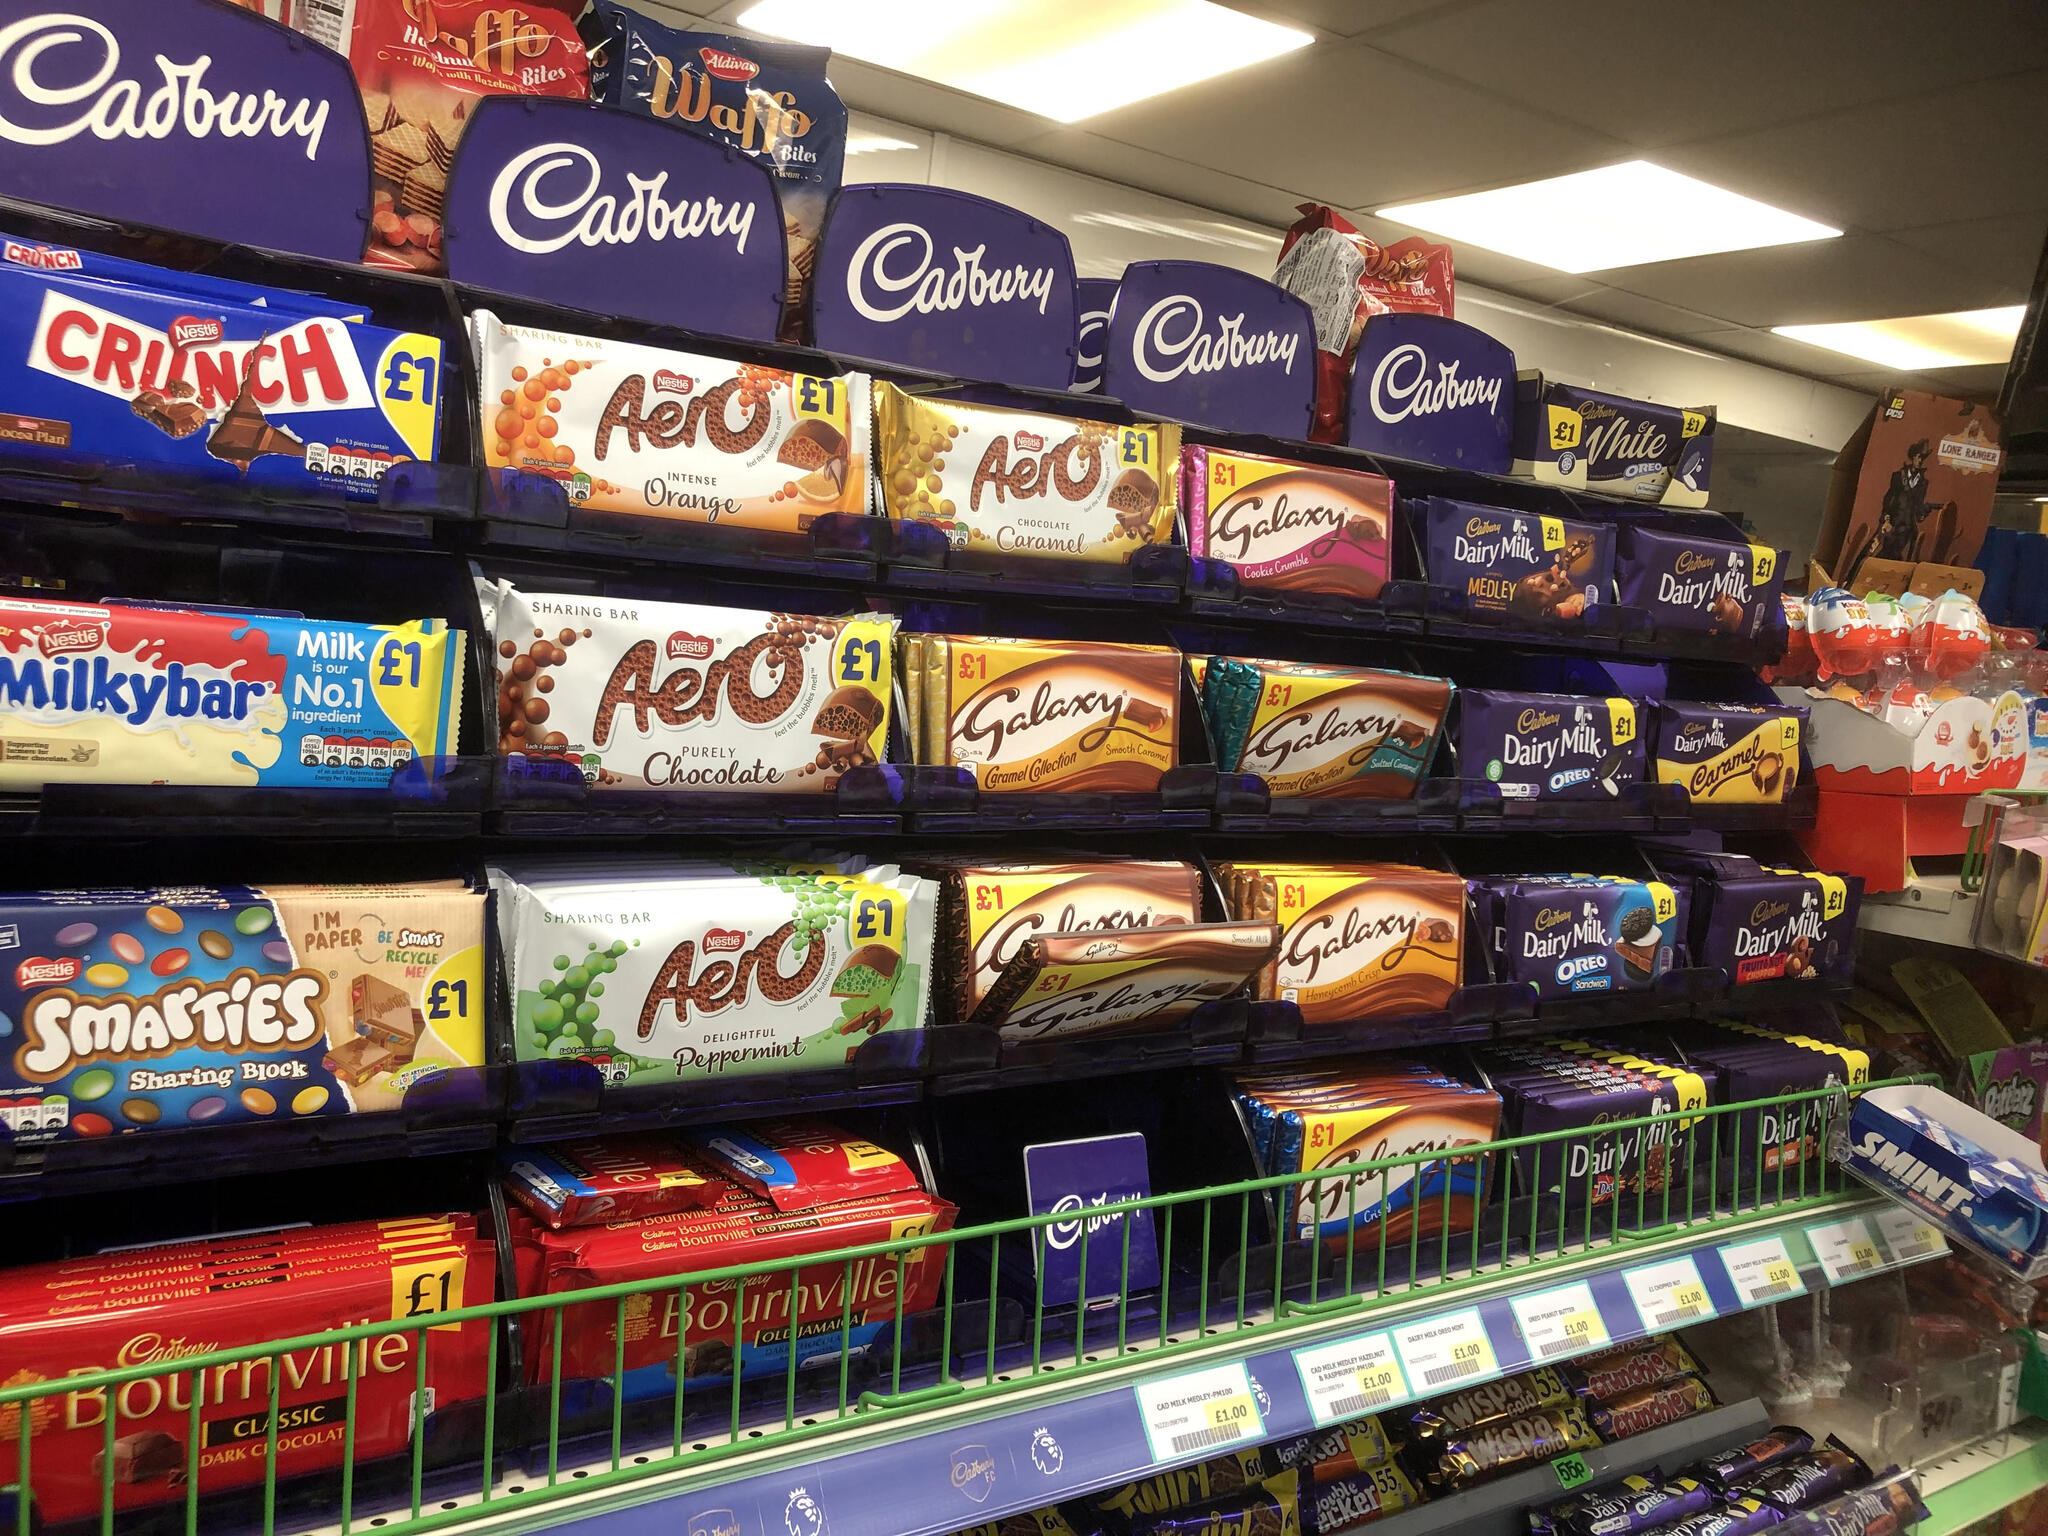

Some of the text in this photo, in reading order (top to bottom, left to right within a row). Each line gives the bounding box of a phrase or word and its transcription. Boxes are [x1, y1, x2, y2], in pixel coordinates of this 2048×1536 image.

[0, 13, 330, 161] Cadbury
[511, 65, 567, 87] Bites
[780, 145, 818, 165] Bites
[489, 143, 756, 255] Cadbury
[7, 245, 79, 268] CRUNCH
[846, 223, 1055, 322] Cadbury
[499, 325, 604, 350] SHARING BAR
[1132, 294, 1300, 383] Cadbury
[45, 309, 350, 409] CRUNCH
[384, 349, 437, 406] £1
[1370, 344, 1503, 424] Cadbury
[799, 376, 835, 416] £1
[594, 373, 772, 462] Aero
[1685, 417, 1701, 433] £1
[37, 431, 67, 446] Plan
[1553, 421, 1576, 443] £1
[1122, 429, 1149, 465] £1
[1941, 443, 1998, 463] LONE RANGER
[667, 471, 718, 487] INTENSE
[970, 434, 1102, 513] Aero
[1214, 462, 1236, 487] £1
[1624, 462, 1663, 478] OREO
[643, 476, 742, 524] Orange
[1017, 518, 1070, 531] CHOCOLATE
[1209, 493, 1347, 561] Galaxy
[1465, 516, 1501, 539] Cadbury
[1546, 526, 1559, 542] £1
[996, 525, 1089, 555] Caramel
[1453, 535, 1539, 568] Dairy Milk
[1244, 553, 1310, 580] Cookie Crumble
[1675, 550, 1716, 576] Cadbury
[1756, 558, 1773, 577] £1
[1467, 576, 1518, 602] MEDLEY
[1658, 573, 1711, 614] Dairy
[532, 600, 640, 622] SHARING BAR
[296, 629, 366, 662] Milk
[311, 661, 348, 675] is our
[378, 638, 422, 689] £1
[841, 637, 881, 682] £1
[958, 653, 987, 680] £1
[0, 656, 266, 726] Milkybar
[593, 632, 803, 747] Aero
[1265, 683, 1293, 708] £1
[292, 707, 363, 725] ingredient
[774, 692, 815, 738] feel the bubbles
[949, 679, 1123, 762] Galaxy
[1517, 708, 1561, 735] Cadbury
[1615, 717, 1633, 738] £1
[1242, 706, 1395, 772] Galaxy
[1674, 732, 1727, 754] Dairy Milk
[1783, 725, 1797, 741] £1
[681, 745, 737, 760] PURELY
[1105, 743, 1169, 765] Smooth Caramel
[1503, 728, 1603, 770] Dairy Milk
[642, 751, 786, 788] Chocolate
[984, 751, 1078, 790] Caramel Collection
[1551, 767, 1592, 789] OREO
[1689, 734, 1765, 798] Caramel
[975, 885, 1005, 912] £1
[1283, 884, 1306, 909] £1
[1658, 898, 1672, 916] £1
[1826, 890, 1844, 911] £1
[313, 910, 341, 931] I'M
[543, 911, 651, 925] SHARING BAR
[856, 898, 894, 939] £1
[1534, 907, 1572, 932] Cadbury
[304, 928, 364, 953] PAPER
[377, 930, 395, 944] BE
[1085, 933, 1269, 959] Galaxy Smooth Milk
[1277, 906, 1417, 984] Galaxy
[1523, 931, 1573, 960] Dairy
[1734, 927, 1786, 958] Dairy
[386, 949, 439, 965] RECYCLE
[1557, 955, 1608, 981] OREO
[404, 966, 428, 979] ME!
[636, 918, 827, 1039] Aero
[1034, 973, 1073, 992] £1
[1304, 967, 1382, 1003] Honeycomb Crisp
[1575, 977, 1608, 990] Sandwich
[427, 979, 468, 1020] £1
[797, 968, 834, 1012] feel the bubbles
[702, 1027, 776, 1044] DELIGHTFUL
[672, 1035, 807, 1076] Peppermint
[129, 1060, 308, 1092] Sharing Block
[1310, 1122, 1335, 1148] £1
[677, 1216, 746, 1236] Bournville
[679, 1208, 896, 1248] Bournville OLD JAMAICA DARK CHOCOLATE
[1855, 1247, 1874, 1261] £1.00
[222, 1276, 273, 1290] CLASSIC
[1770, 1267, 1790, 1283] £1.00
[405, 1270, 451, 1318] £1
[660, 1258, 898, 1339] Bournville
[1680, 1290, 1702, 1306] £1.00
[1540, 1309, 1559, 1321] PEANUT
[1558, 1306, 1576, 1317] BUTTER
[1407, 1323, 1465, 1344] DAIRY MILK OREO MINT
[1564, 1320, 1589, 1336] £1.00
[1310, 1349, 1386, 1375] CAD MILK MEDLEY HAZELNUT
[1454, 1343, 1481, 1360] £1.00
[66, 1318, 411, 1431] Bournville
[1363, 1372, 1392, 1390] £1.00
[1156, 1401, 1170, 1411] CAD
[1170, 1397, 1187, 1408] MILK
[1215, 1404, 1248, 1424] £1.00
[201, 1447, 247, 1468] DARK
[950, 1457, 996, 1488] Cadbury
[1554, 1463, 1586, 1483] 55p
[1634, 1493, 1668, 1519] OREO
